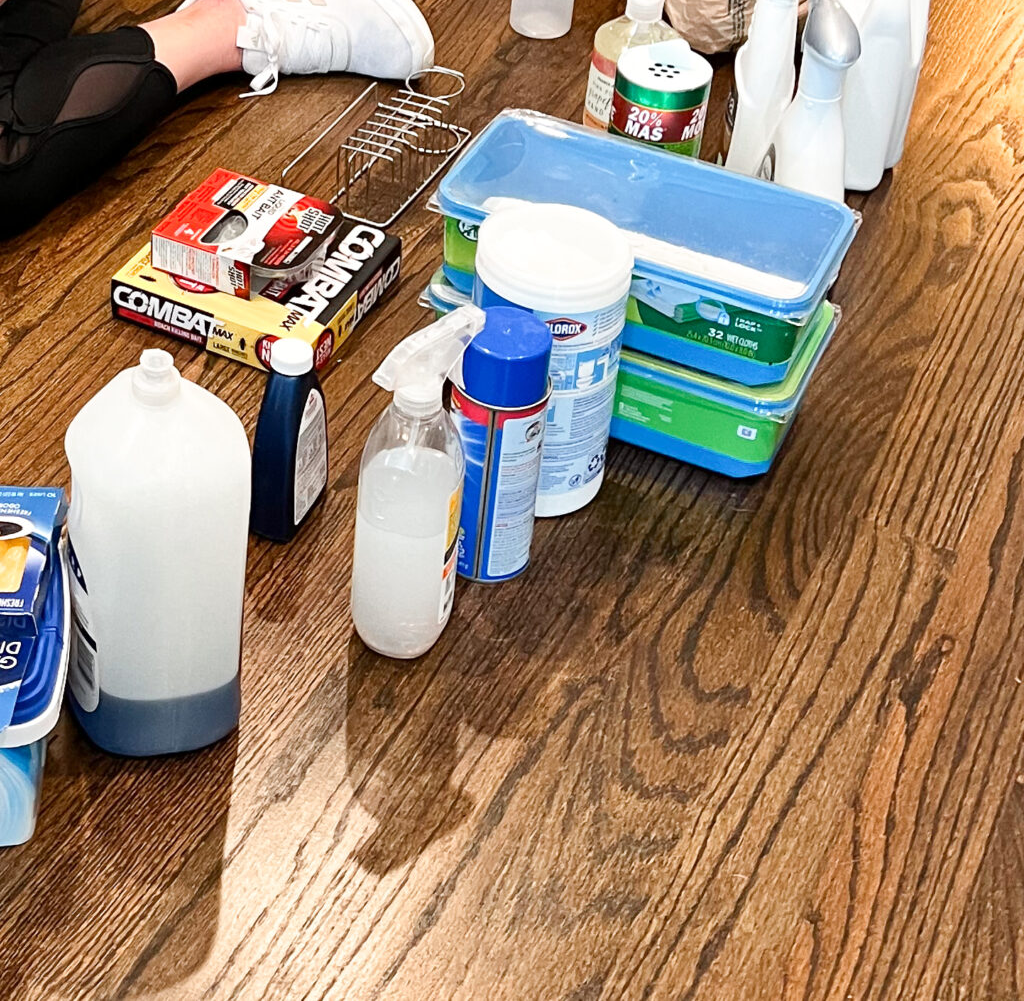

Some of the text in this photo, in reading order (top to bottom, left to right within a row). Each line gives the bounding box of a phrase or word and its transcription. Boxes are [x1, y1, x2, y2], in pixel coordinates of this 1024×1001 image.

[628, 106, 663, 127] 20%
[268, 189, 284, 205] ANT
[251, 202, 271, 220] BAIT
[298, 208, 320, 230] SHOT
[312, 215, 331, 231] HOT
[285, 225, 385, 328] COMBAT
[113, 285, 226, 338] COMBAT
[280, 309, 304, 332] MAX
[212, 327, 234, 341] MAX
[547, 323, 582, 335] LOROX
[708, 328, 724, 340] 32
